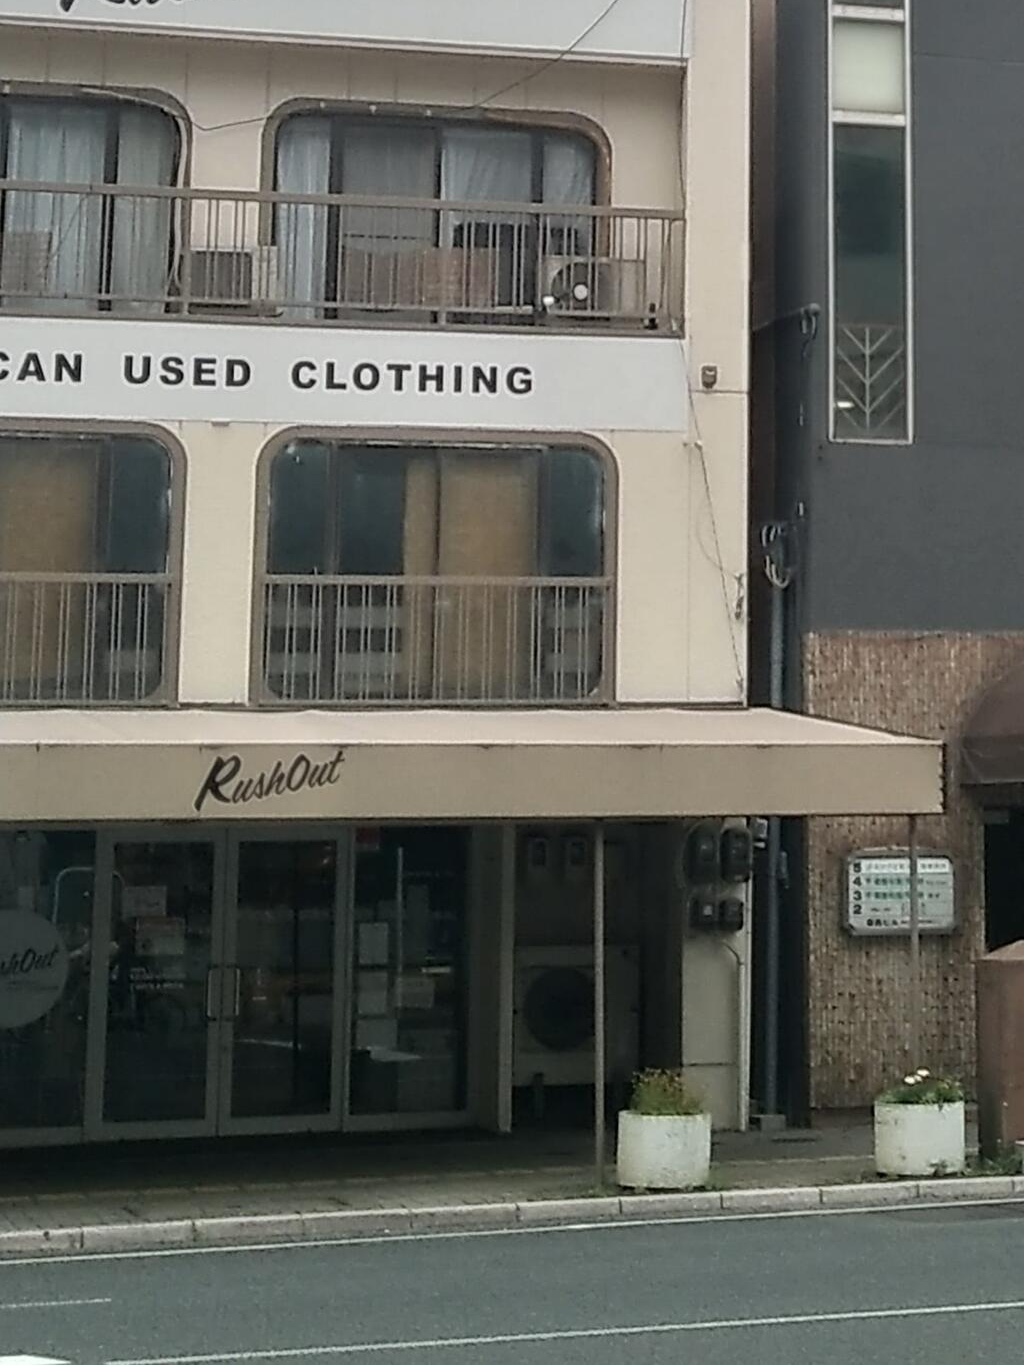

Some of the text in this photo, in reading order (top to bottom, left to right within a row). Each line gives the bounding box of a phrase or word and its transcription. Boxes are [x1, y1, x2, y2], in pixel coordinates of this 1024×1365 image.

[123, 354, 252, 388] USED
[291, 360, 535, 395] CLOTHING
[194, 751, 345, 811] RushOut
[853, 876, 863, 887] 4
[853, 890, 863, 902] 3
[853, 904, 863, 915] 2
